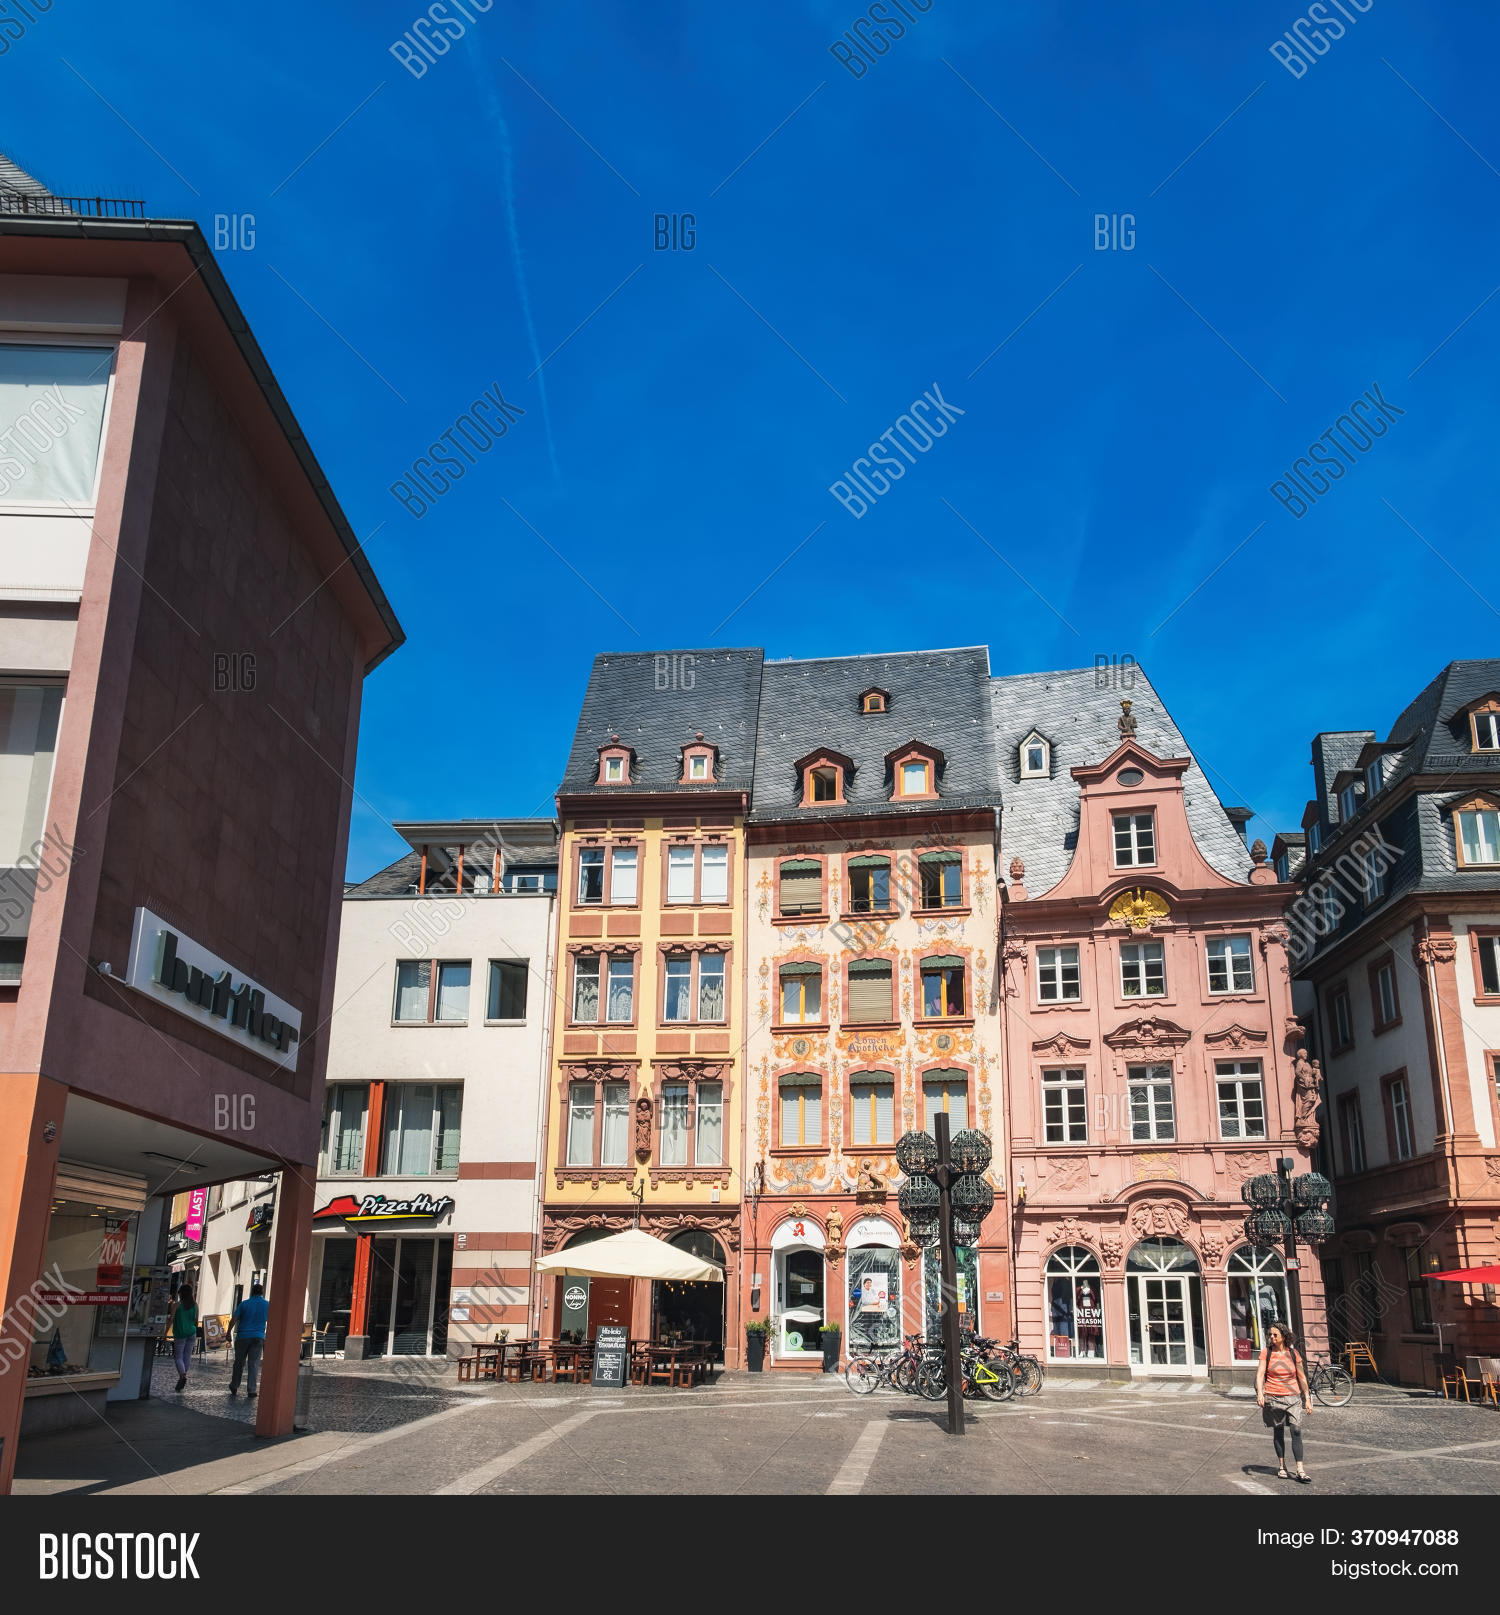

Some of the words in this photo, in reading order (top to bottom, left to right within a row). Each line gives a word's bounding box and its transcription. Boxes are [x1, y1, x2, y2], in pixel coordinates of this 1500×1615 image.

[358, 1196, 408, 1216] Pizza
[410, 1194, 452, 1213] Hut
[457, 1234, 467, 1242] 2
[1077, 1308, 1102, 1318] NEW
